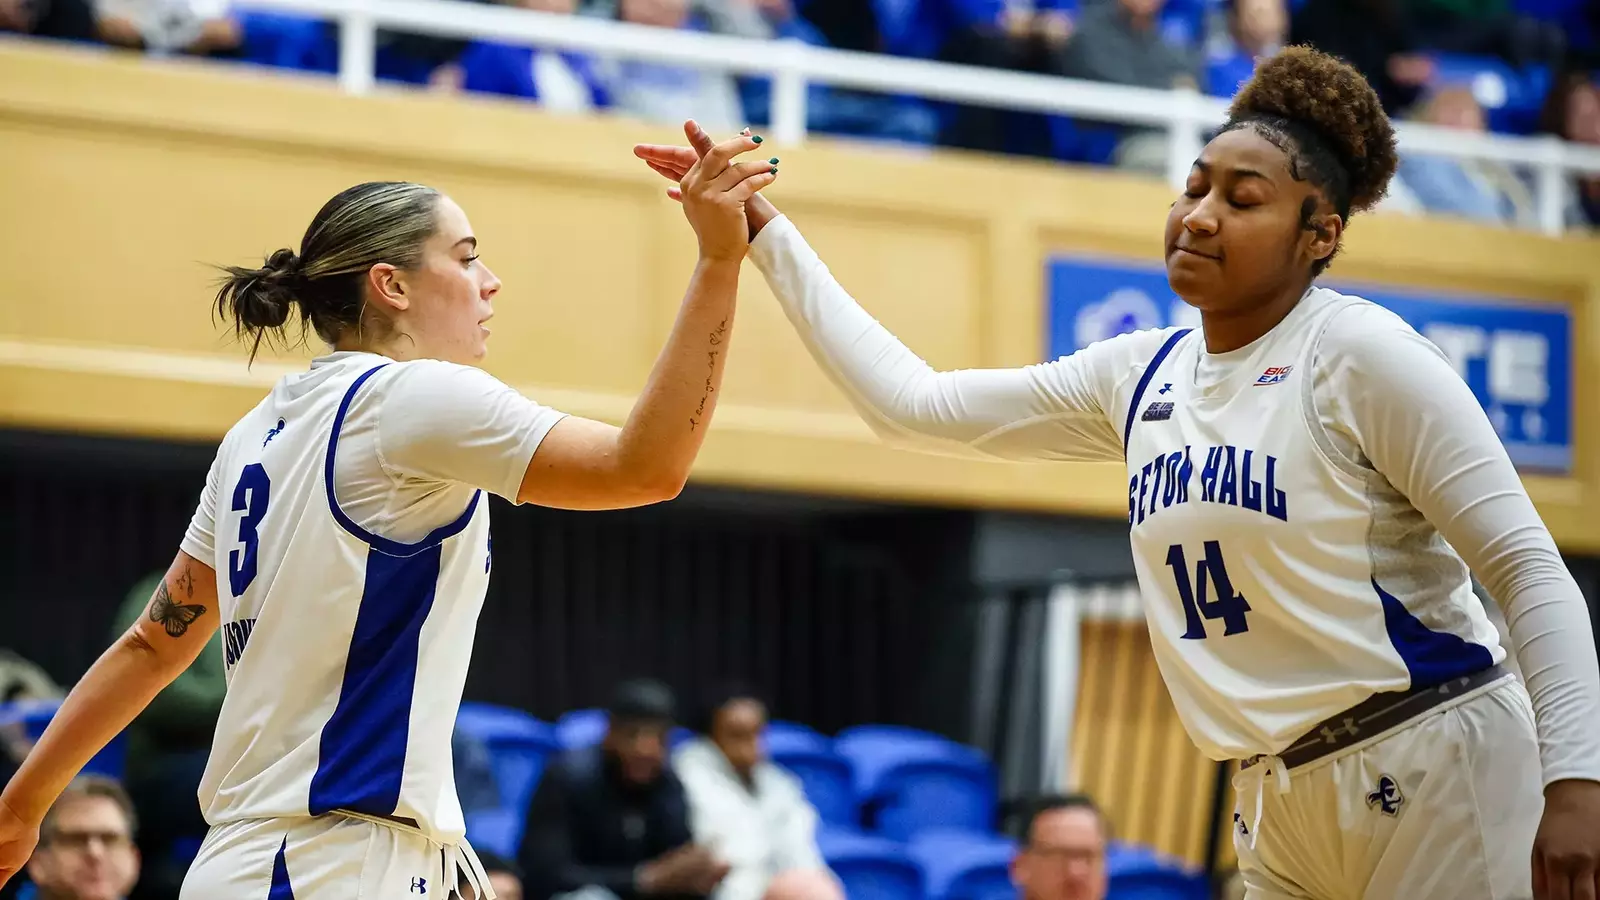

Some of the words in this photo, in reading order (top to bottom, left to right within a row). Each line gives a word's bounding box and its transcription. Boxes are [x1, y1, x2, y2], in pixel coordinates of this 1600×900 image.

[1257, 373, 1289, 383] EAS
[1263, 365, 1294, 376] BIG
[1128, 445, 1193, 526] SETON
[1201, 445, 1288, 522] HALL
[229, 462, 271, 598] 3
[1165, 540, 1252, 640] 14
